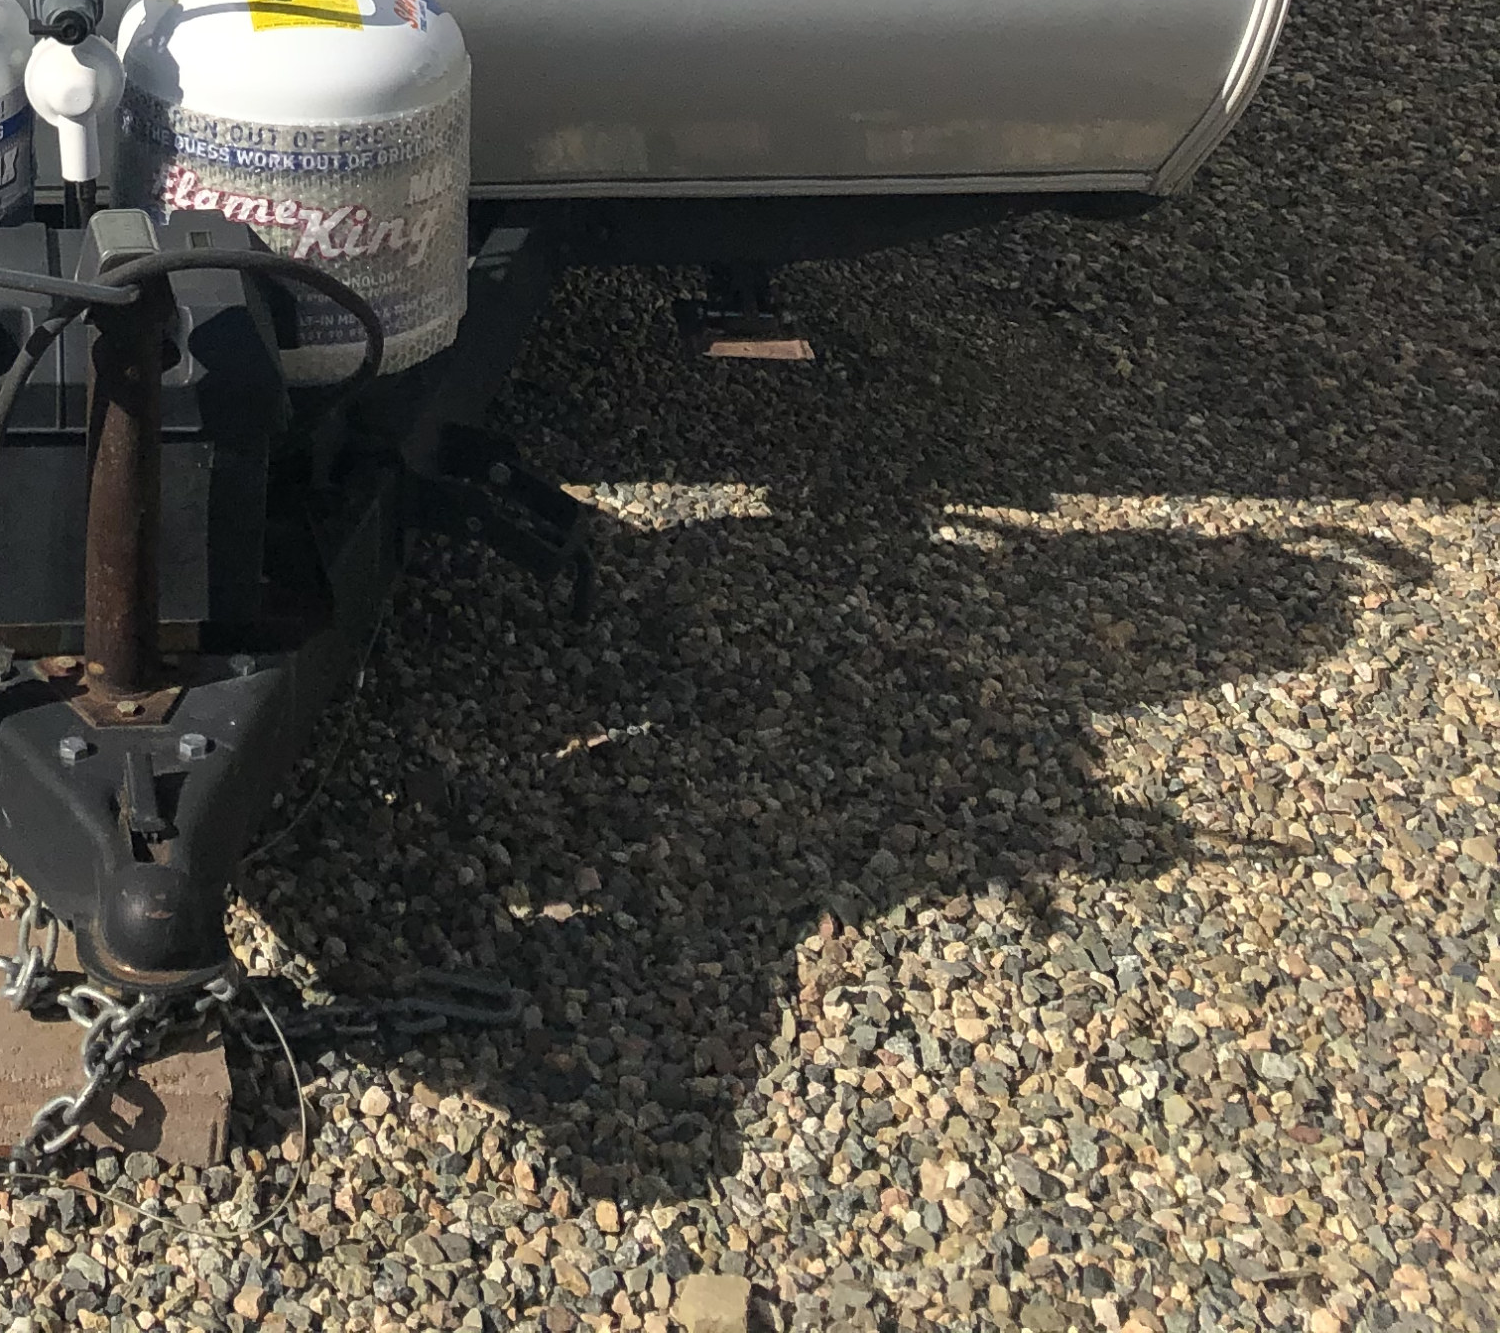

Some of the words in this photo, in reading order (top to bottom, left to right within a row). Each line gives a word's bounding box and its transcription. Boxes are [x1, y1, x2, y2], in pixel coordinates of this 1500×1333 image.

[174, 135, 230, 163] GUESS
[236, 148, 296, 170] WORK
[302, 153, 342, 170] OUT
[349, 150, 373, 169] OF
[230, 125, 279, 147] OUT
[293, 130, 326, 149] OF
[291, 203, 442, 268] King
